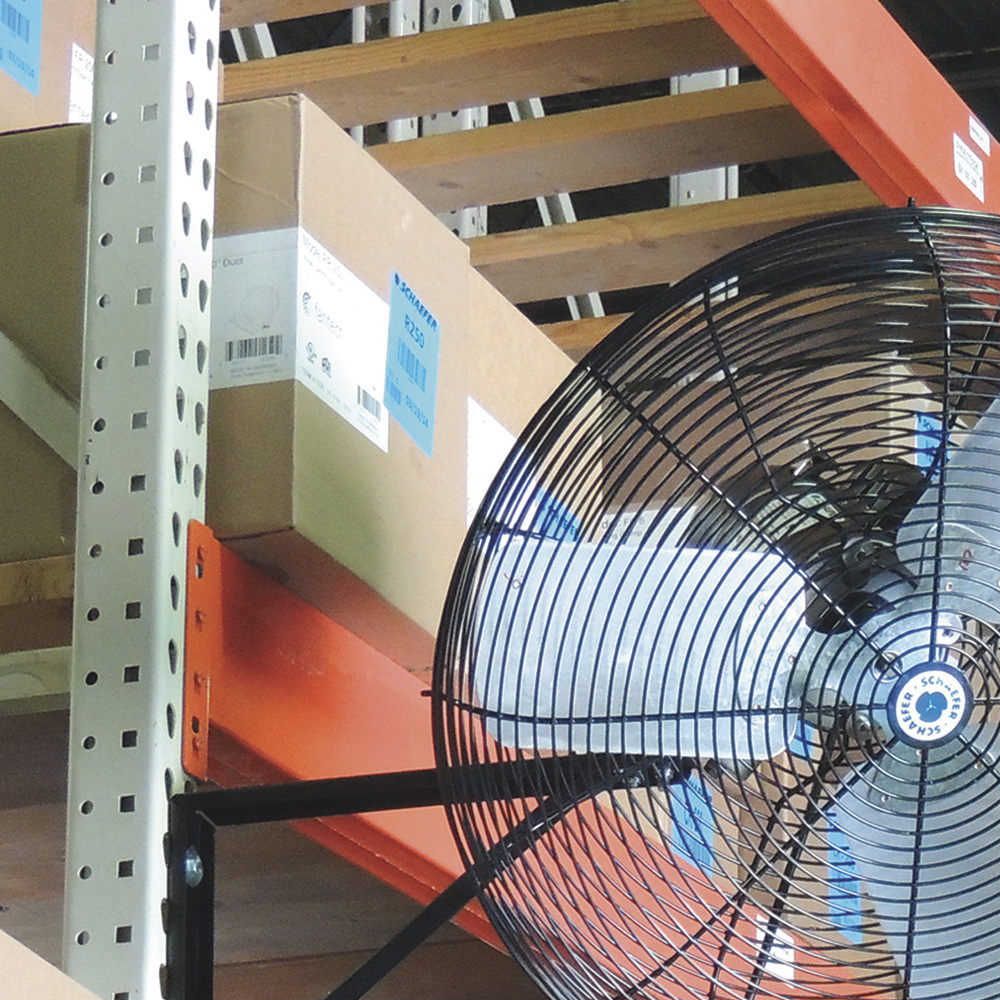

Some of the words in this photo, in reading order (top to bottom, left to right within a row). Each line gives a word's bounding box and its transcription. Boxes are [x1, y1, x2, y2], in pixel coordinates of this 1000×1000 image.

[222, 256, 245, 268] Duct
[400, 281, 438, 332] SCHAEFER
[404, 313, 426, 349] R250
[900, 691, 942, 737] SCHAEFER
